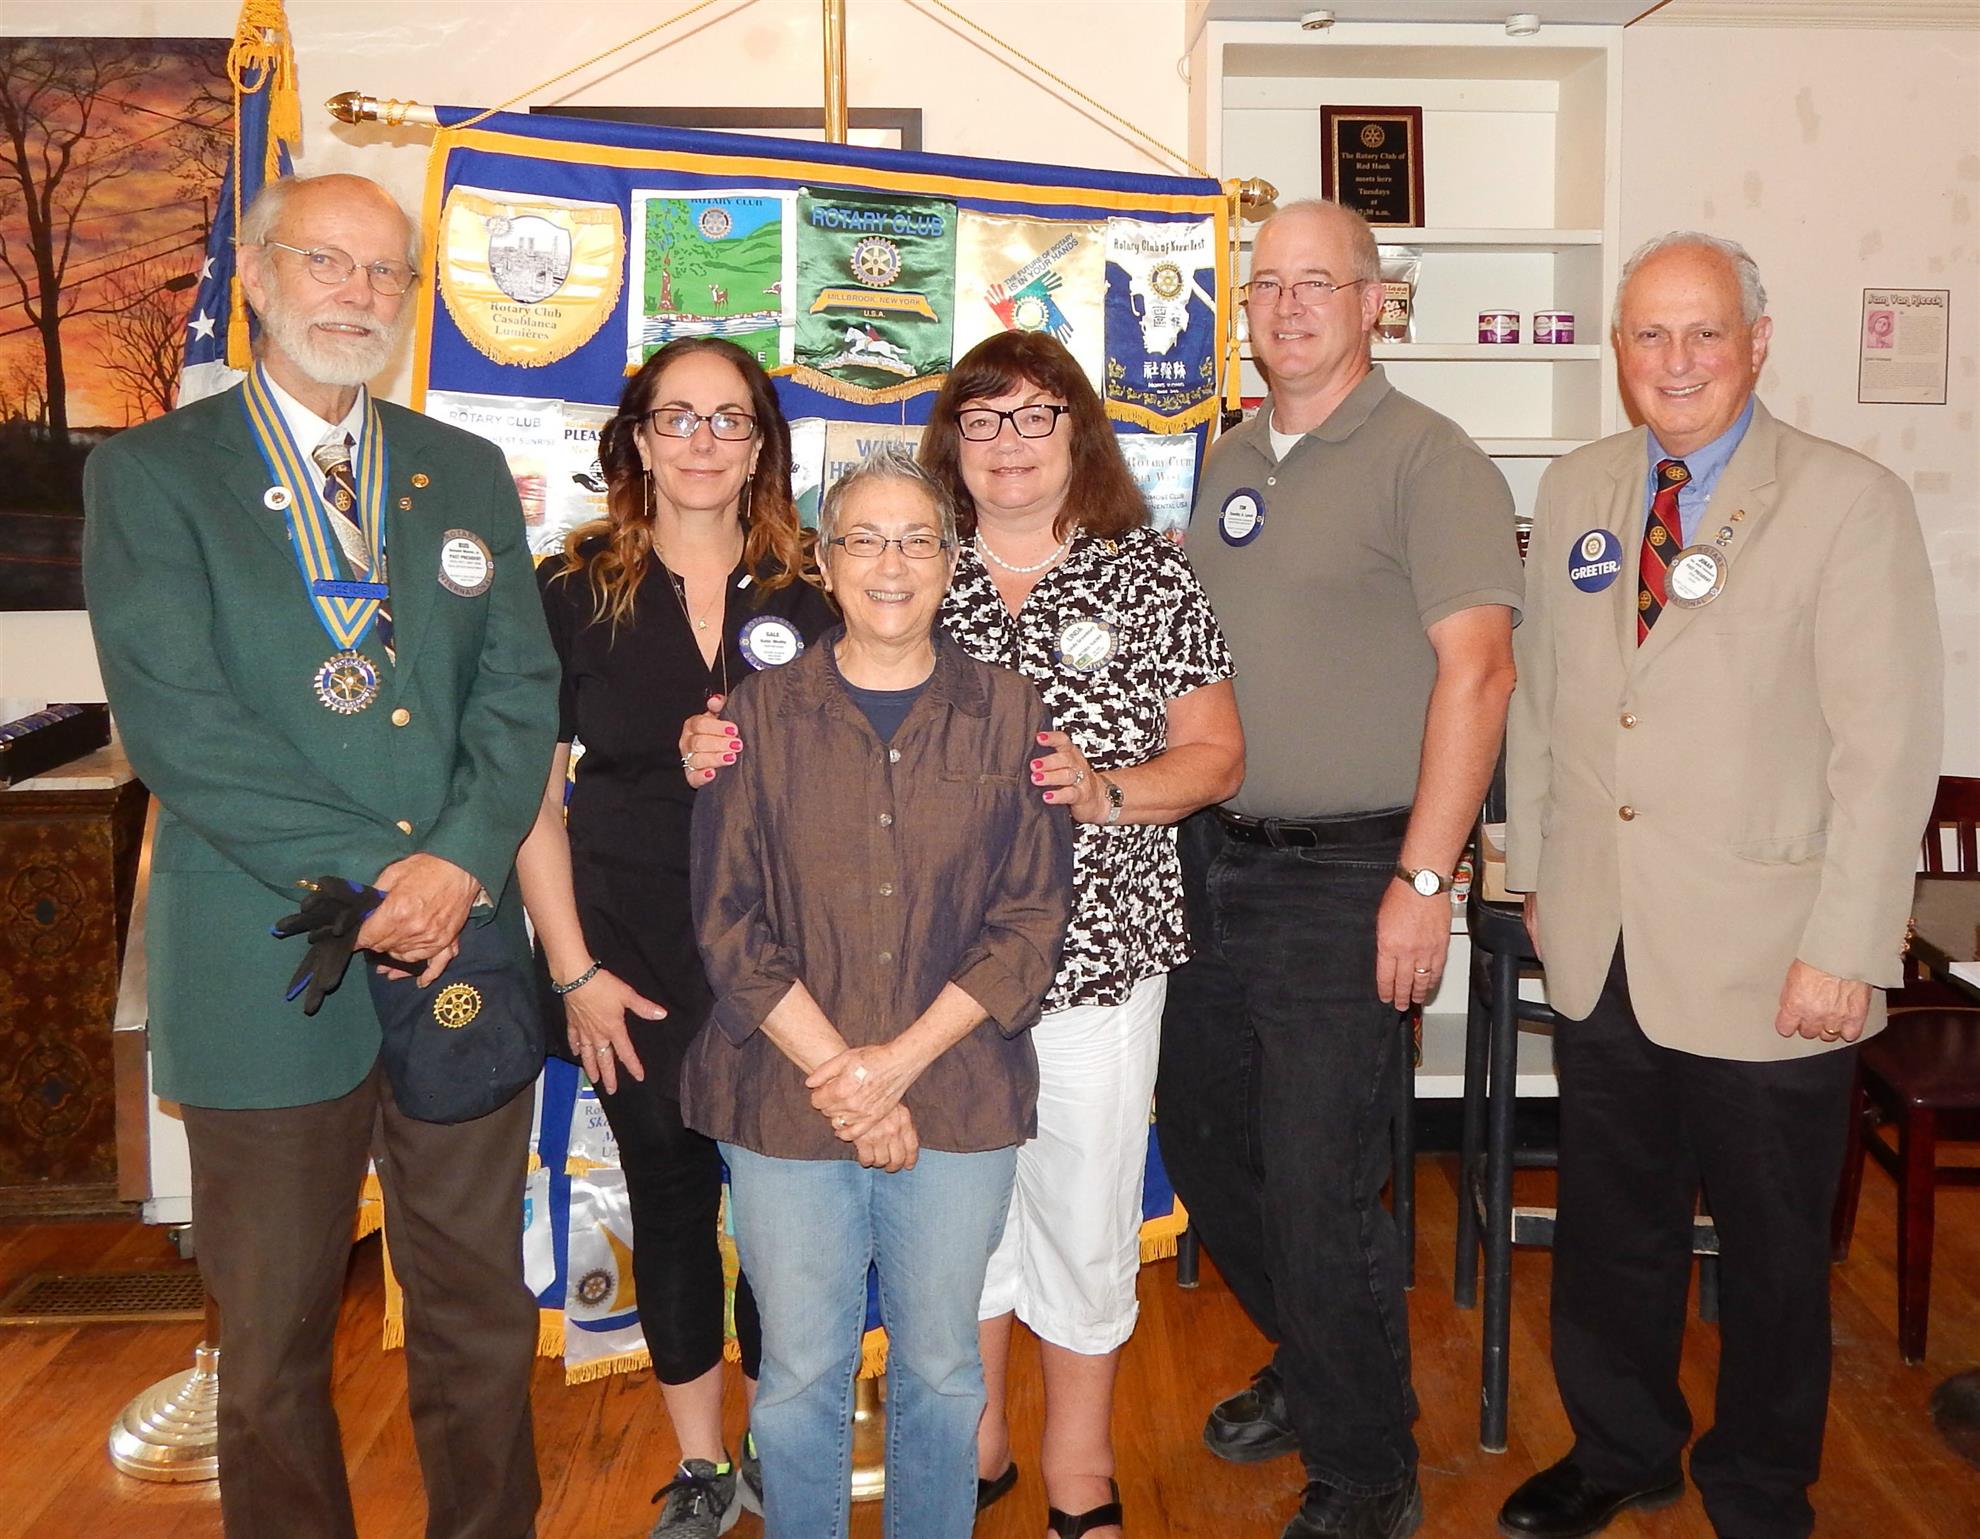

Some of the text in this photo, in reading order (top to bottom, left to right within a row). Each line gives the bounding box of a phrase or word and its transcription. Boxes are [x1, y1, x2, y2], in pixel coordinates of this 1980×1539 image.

[1355, 152, 1378, 160] Rotary
[1380, 152, 1397, 160] Club
[1398, 152, 1406, 160] of
[1359, 188, 1390, 196] Tuesdays
[811, 206, 945, 236] ROTARY CLUB
[1114, 238, 1140, 255] Rotary
[1141, 240, 1160, 252] Club
[1161, 242, 1169, 255] of
[1004, 232, 1074, 286] THE FUTURE OF ROTARY
[1008, 282, 1018, 291] IS
[1027, 259, 1052, 278] YOUR
[1051, 238, 1079, 262] HANDS
[490, 302, 562, 318] Rotary Club
[863, 310, 886, 318] U.S.A.
[492, 313, 557, 329] Casablanca
[449, 411, 541, 428] ROTARY CLUB
[1571, 560, 1618, 580] GREETER
